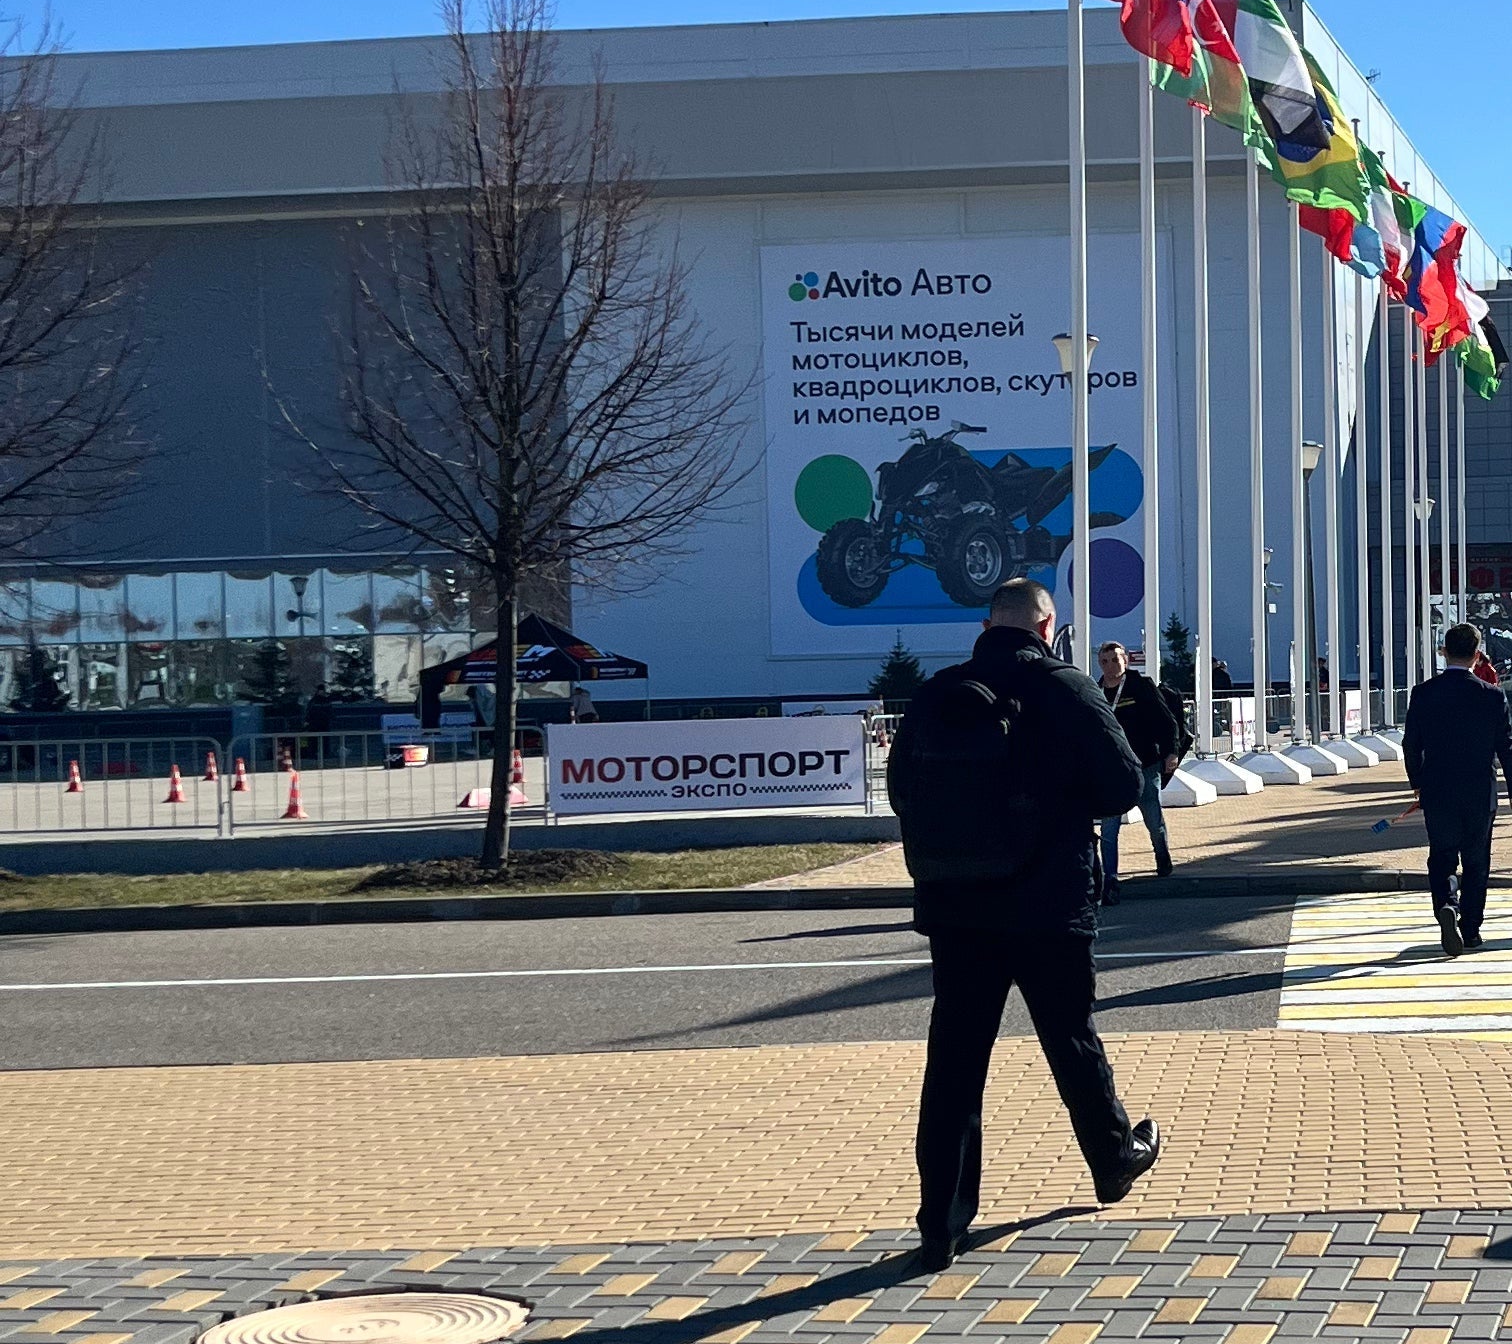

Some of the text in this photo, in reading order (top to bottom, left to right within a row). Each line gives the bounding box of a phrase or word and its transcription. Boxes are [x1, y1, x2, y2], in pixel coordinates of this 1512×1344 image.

[822, 268, 992, 298] Avito Авто
[790, 313, 1025, 343] Тысячи моделей
[792, 349, 969, 371] мотоциклов,
[793, 371, 1137, 401] квадроциклов, скутров
[794, 405, 941, 426] и мопедов
[562, 750, 850, 784] МОТОРСПОРТ
[671, 783, 748, 799] ЭКСПО
